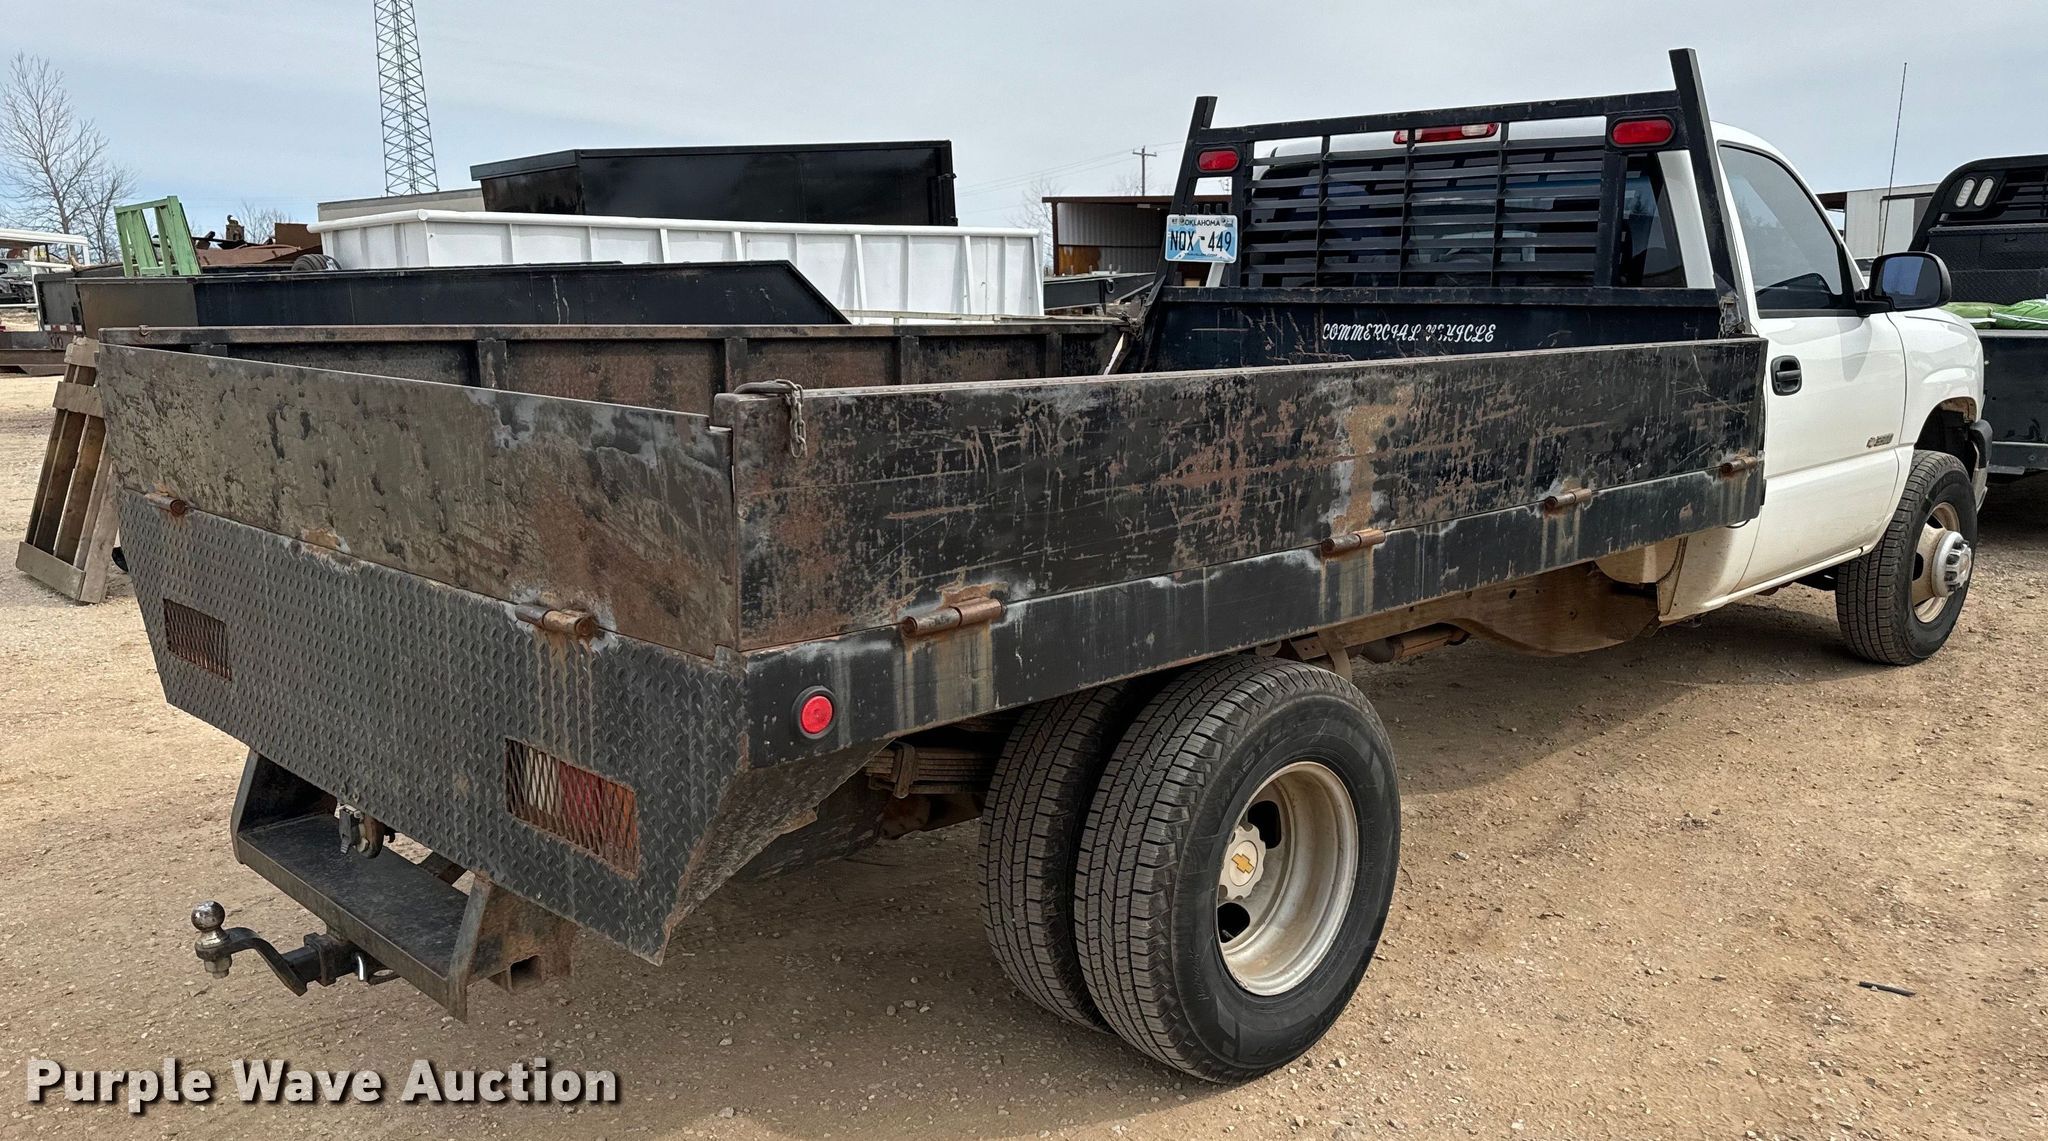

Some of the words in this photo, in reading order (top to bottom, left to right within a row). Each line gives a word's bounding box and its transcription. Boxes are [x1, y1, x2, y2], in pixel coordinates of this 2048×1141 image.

[1184, 219, 1220, 227] OKLAHOMA
[1170, 230, 1195, 252] NQX
[1207, 230, 1232, 252] 449
[1322, 323, 1422, 342] COMMERCIAL
